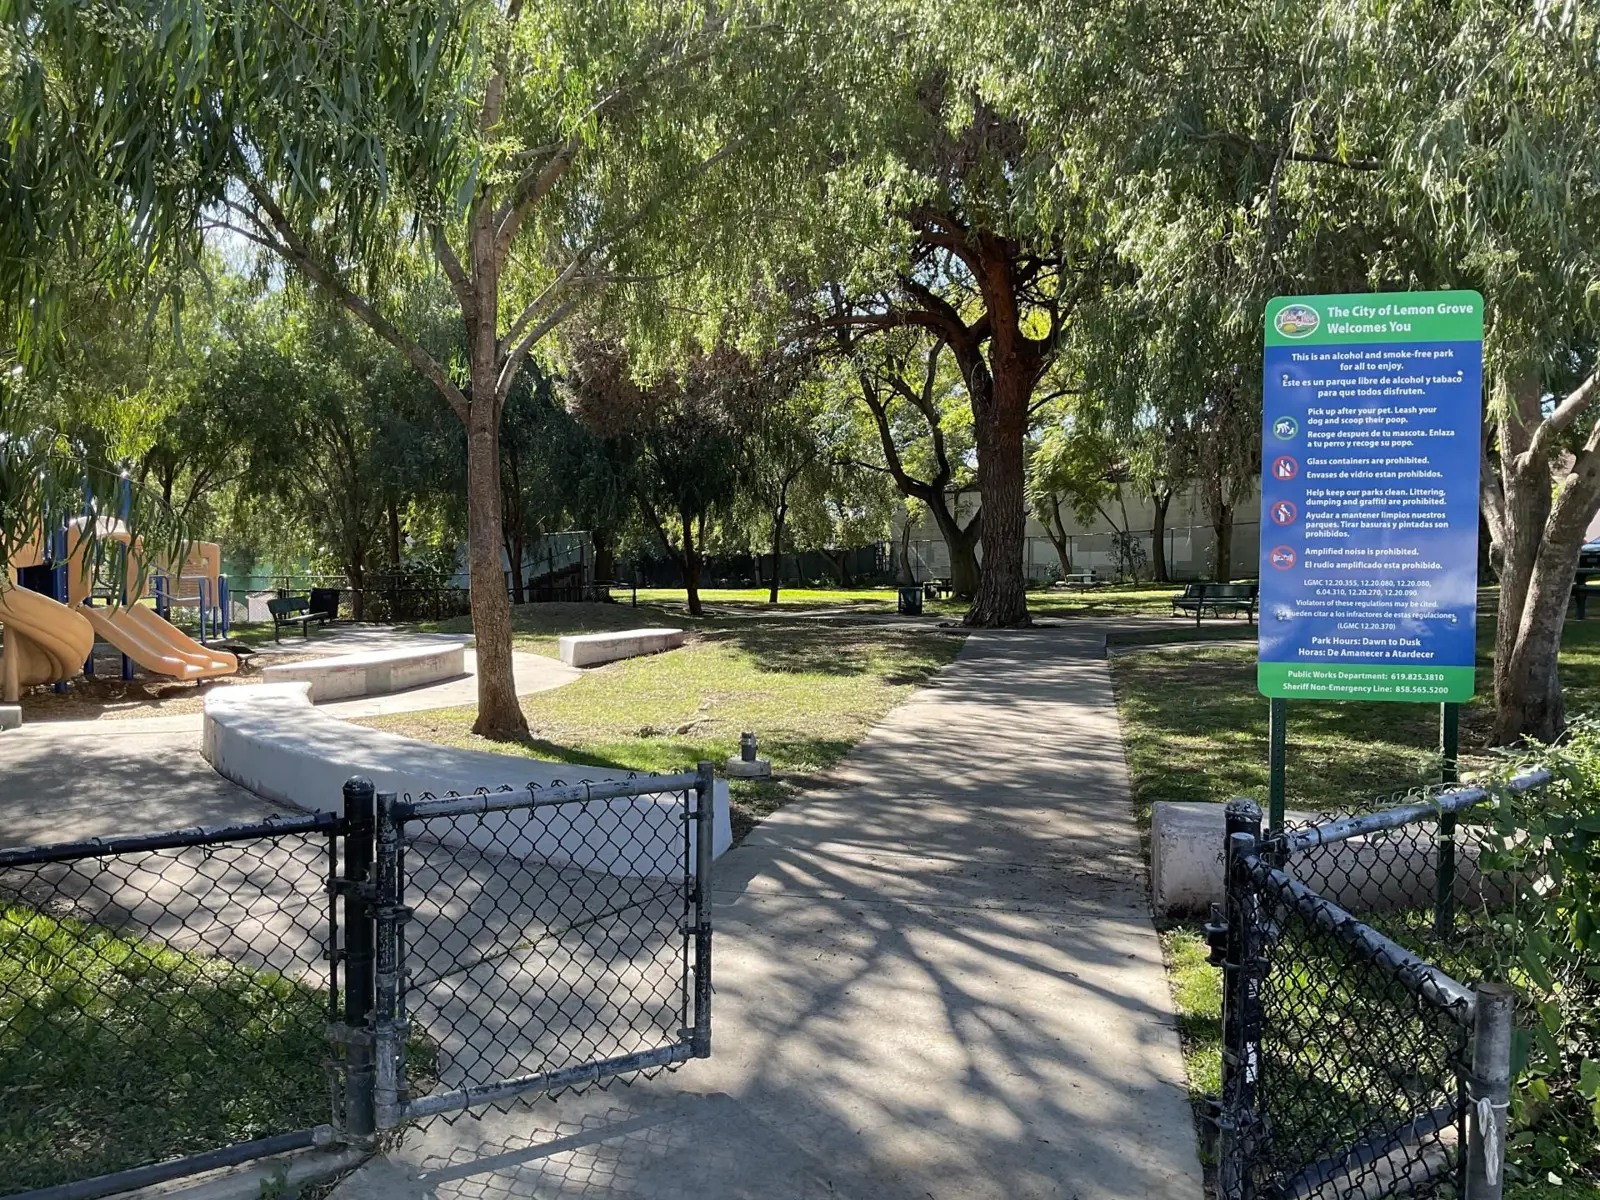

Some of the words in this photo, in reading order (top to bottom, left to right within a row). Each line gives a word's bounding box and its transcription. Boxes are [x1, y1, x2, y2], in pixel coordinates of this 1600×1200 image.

[1328, 306, 1349, 317] The
[1352, 306, 1375, 319] City
[1378, 305, 1390, 316] of
[1393, 304, 1434, 315] Lemon
[1437, 303, 1473, 314] Grove
[1328, 322, 1386, 334] Welcomes
[1389, 321, 1411, 333] You
[1383, 350, 1431, 358] smoke-free
[1433, 349, 1454, 359] park
[1326, 378, 1356, 387] parque
[1358, 376, 1377, 384] libre
[1392, 375, 1423, 383] alcohol
[1432, 374, 1462, 383] tabaco
[1318, 390, 1337, 398] para
[1383, 387, 1425, 395] disfruten.
[1377, 406, 1392, 415] pet.
[1307, 417, 1322, 425] dog
[1307, 430, 1335, 439] Recoge
[1337, 430, 1368, 438] despues
[1385, 457, 1429, 465] prohibited.
[1398, 470, 1443, 479] prohibidos.
[1306, 489, 1324, 497] Help
[1326, 489, 1344, 497] keep
[1361, 488, 1383, 497] parks
[1409, 488, 1446, 497] Littering,
[1306, 498, 1341, 506] dumping
[1359, 498, 1386, 506] graffiti
[1402, 497, 1446, 506] prohibited.
[1306, 512, 1333, 520] Ayudar
[1381, 511, 1409, 520] limpios
[1398, 520, 1432, 529] pintadas
[1306, 530, 1350, 538] prohibidos.
[1305, 548, 1342, 556] Amplified
[1375, 548, 1419, 556] prohibited.
[1336, 561, 1382, 570] amplificado
[1402, 561, 1443, 570] prohibido.
[1354, 600, 1392, 608] regulations
[1361, 623, 1396, 631] 12.20.370)
[1312, 637, 1330, 645] Park
[1333, 637, 1360, 645] Hours:
[1362, 637, 1386, 645] Dawn
[1388, 637, 1397, 646] to
[1399, 637, 1421, 646] Dusk
[1298, 648, 1325, 657] Horas:
[1327, 648, 1338, 657] De
[1340, 648, 1383, 657] Amanecer
[1392, 649, 1435, 658] Atardecer
[1338, 672, 1387, 680] Department:
[1310, 684, 1371, 693] Non-Emergency
